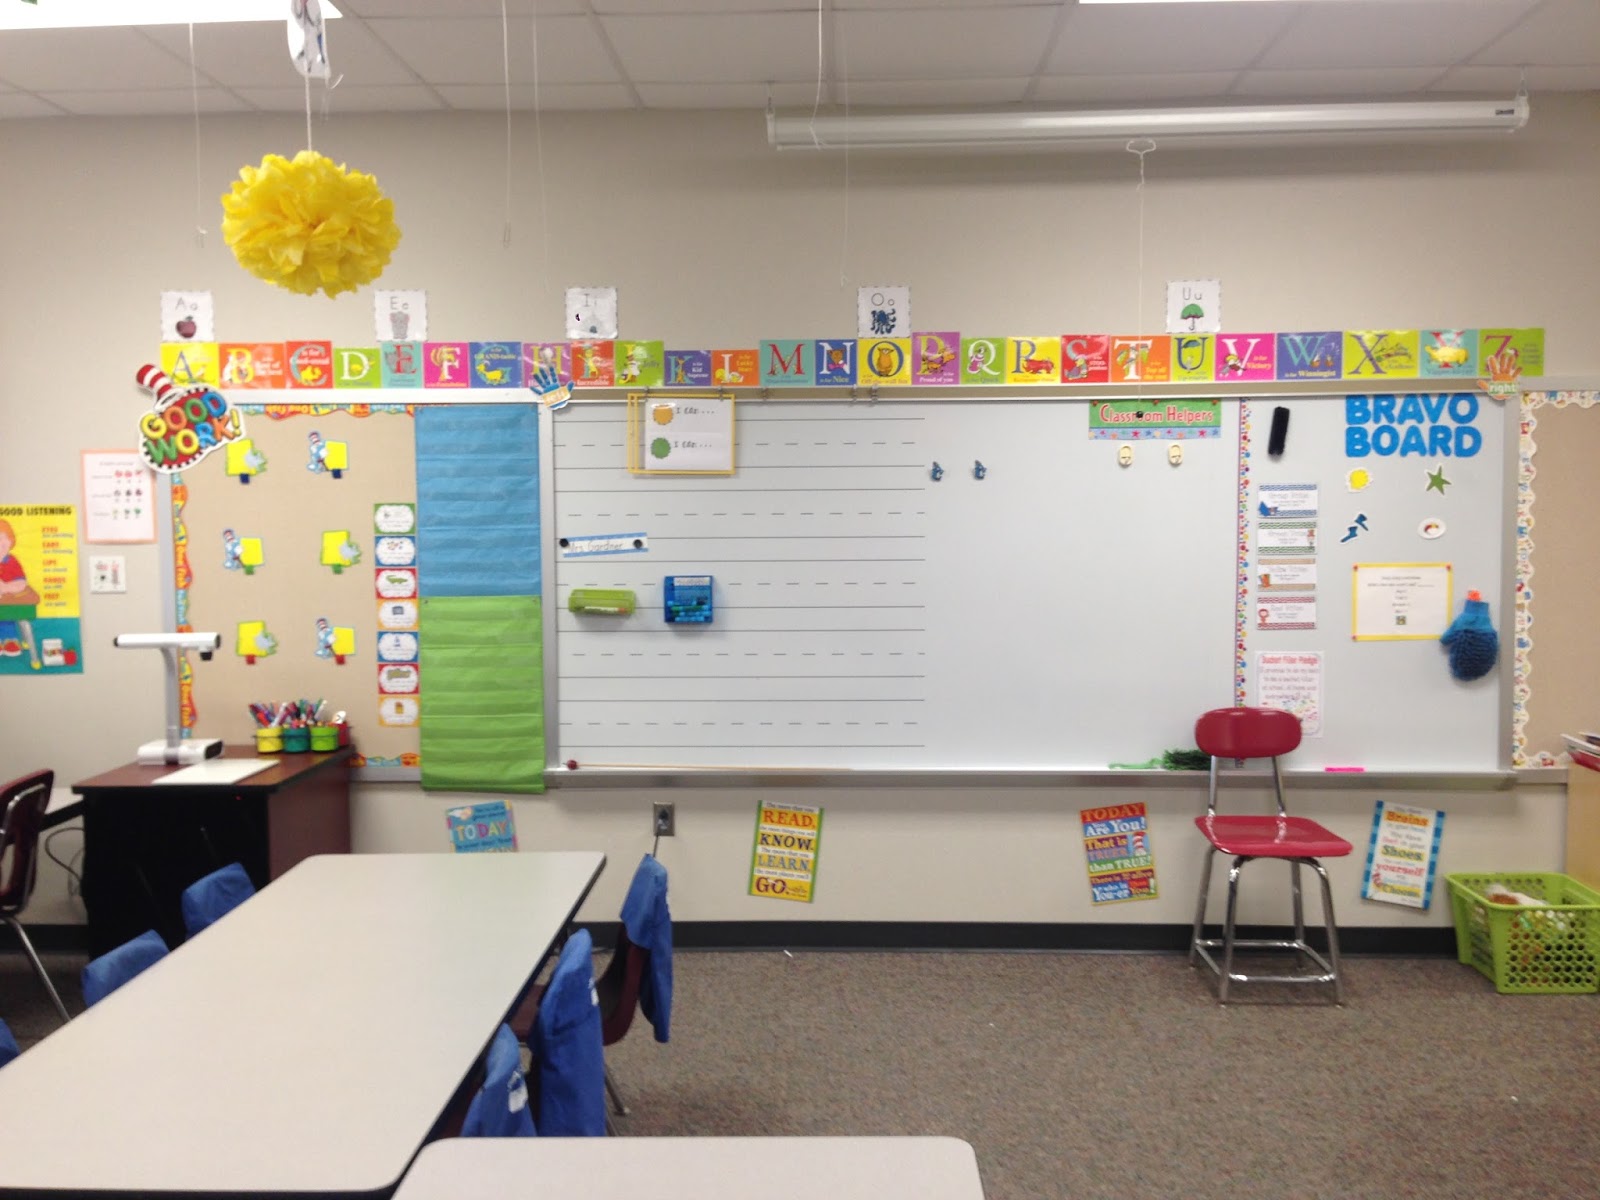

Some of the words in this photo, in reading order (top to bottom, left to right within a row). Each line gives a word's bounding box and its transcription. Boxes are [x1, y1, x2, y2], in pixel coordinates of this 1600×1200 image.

[226, 348, 255, 384] B
[290, 344, 329, 386] C
[340, 351, 370, 380] D
[393, 344, 416, 375] E
[440, 347, 461, 380] F
[475, 344, 513, 386] G
[767, 343, 806, 376] M
[819, 342, 854, 375] N
[867, 340, 904, 378] O
[916, 335, 946, 375] P
[966, 339, 1001, 376] Q
[1011, 339, 1044, 375] R
[1113, 338, 1153, 380] T
[1174, 337, 1209, 371] U
[1221, 338, 1261, 377] V
[1282, 335, 1326, 367] W
[1348, 334, 1388, 375] X
[1430, 331, 1466, 369] Y
[171, 351, 195, 384] A
[667, 355, 695, 384] K
[720, 354, 744, 383] L
[1489, 383, 1517, 394] right
[141, 392, 228, 440] GOOD
[1166, 404, 1214, 426] Helpers
[1345, 393, 1479, 425] BRAVO
[145, 408, 242, 465] WORK!
[1345, 425, 1482, 458] BOARD
[0, 507, 23, 516] GOOD
[26, 506, 72, 516] LISTENING
[1083, 804, 1144, 821] TODAY
[1109, 817, 1147, 834] You!
[457, 821, 507, 841] TODAY
[1085, 838, 1114, 850] That
[1116, 837, 1127, 846] is
[1089, 862, 1114, 873] than
[1114, 856, 1152, 870] TRUE!
